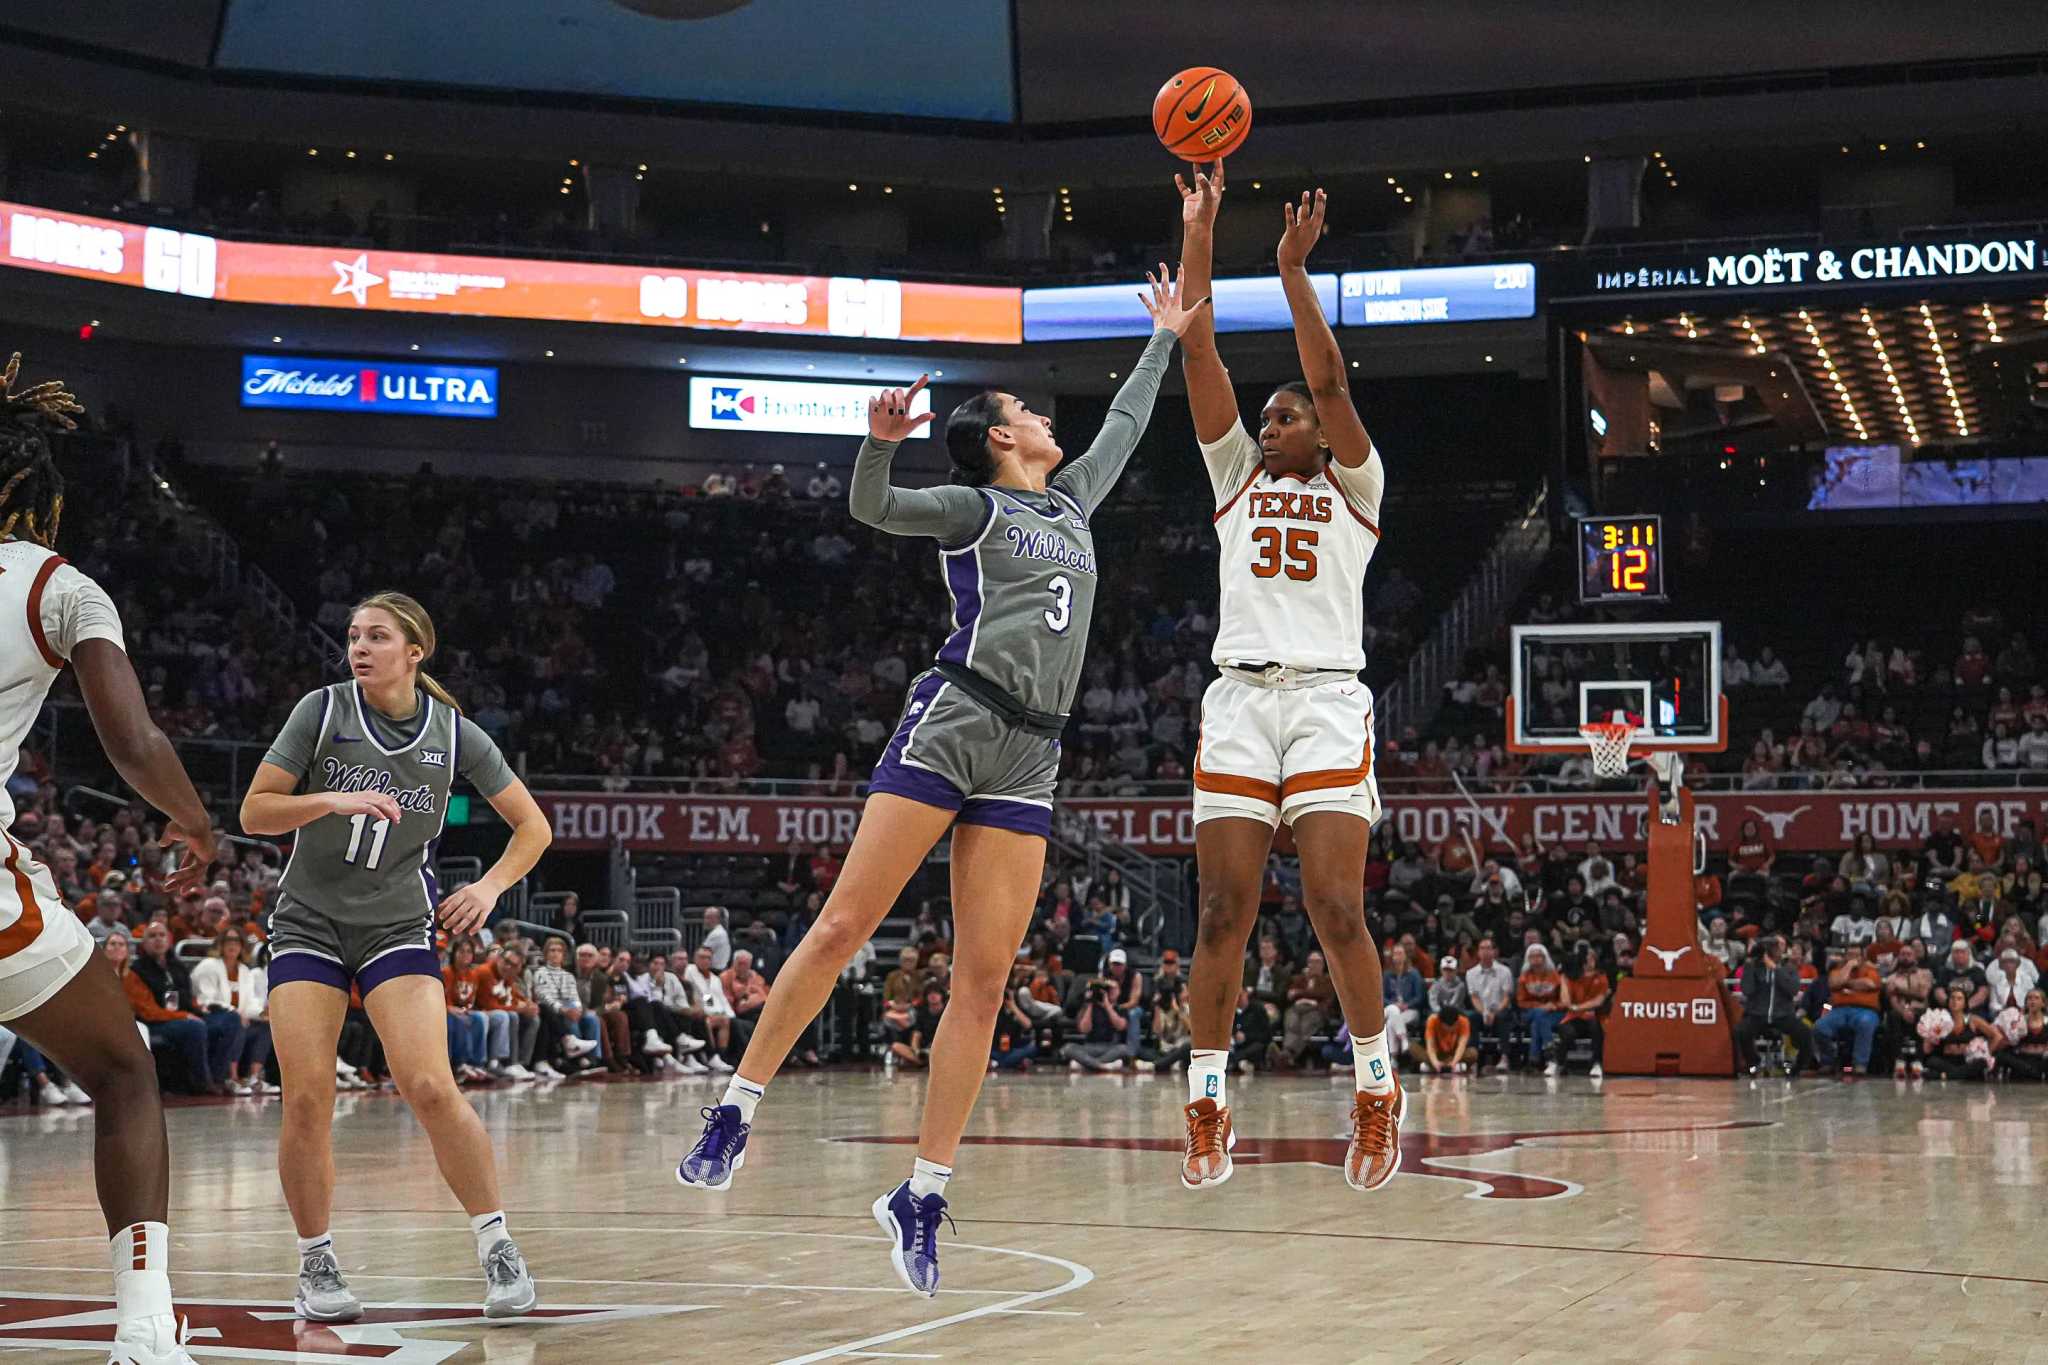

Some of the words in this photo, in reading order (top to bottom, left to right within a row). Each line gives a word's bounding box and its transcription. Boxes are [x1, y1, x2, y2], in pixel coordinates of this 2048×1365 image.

[1201, 104, 1244, 149] ELITE
[1706, 248, 1808, 287] MOËT
[1816, 250, 1843, 281] &
[1850, 240, 2035, 279] CHANDON
[244, 369, 357, 396] Michelob
[383, 376, 493, 404] ULTRA
[1249, 491, 1333, 523] TEXAS
[1005, 524, 1097, 575] Wildcat
[1250, 526, 1319, 582] 35
[1603, 525, 1654, 549] 3:11
[1612, 549, 1647, 590] 12
[1044, 574, 1073, 633] 3
[553, 803, 665, 840] HOOK
[776, 808, 866, 844] HOR
[1377, 806, 1509, 842] OODY
[1532, 804, 1719, 841] CENTR
[1975, 801, 2026, 838] OF
[344, 814, 391, 870] 11
[1620, 1001, 1689, 1019] TRUIST
